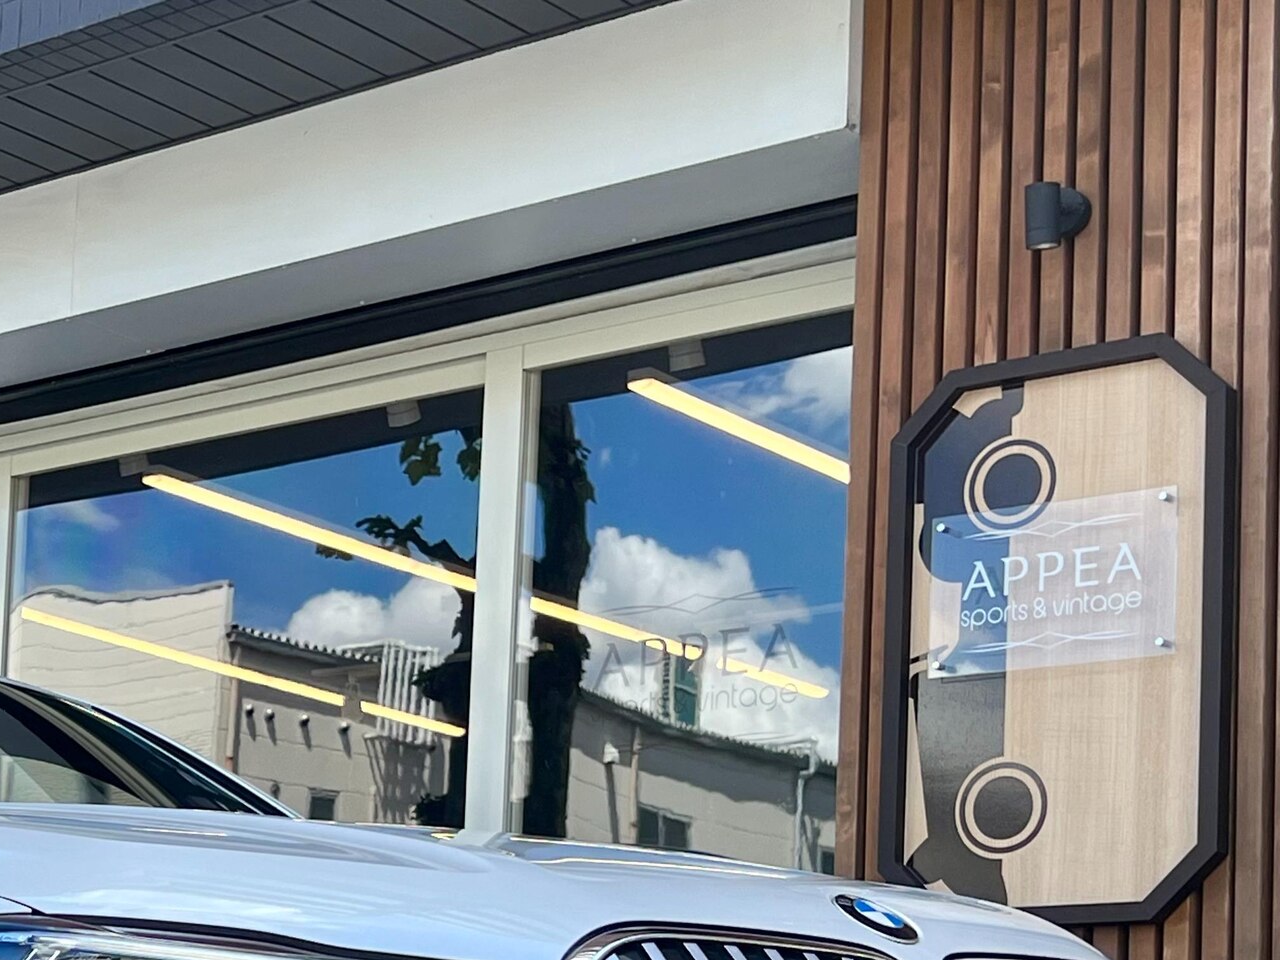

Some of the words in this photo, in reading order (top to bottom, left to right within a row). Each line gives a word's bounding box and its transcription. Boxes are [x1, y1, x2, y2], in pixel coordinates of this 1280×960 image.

[961, 542, 1143, 601] APPEA
[960, 600, 1029, 631] sports
[1032, 596, 1048, 620] &
[1052, 590, 1143, 617] vintage
[593, 623, 799, 690] APPEA
